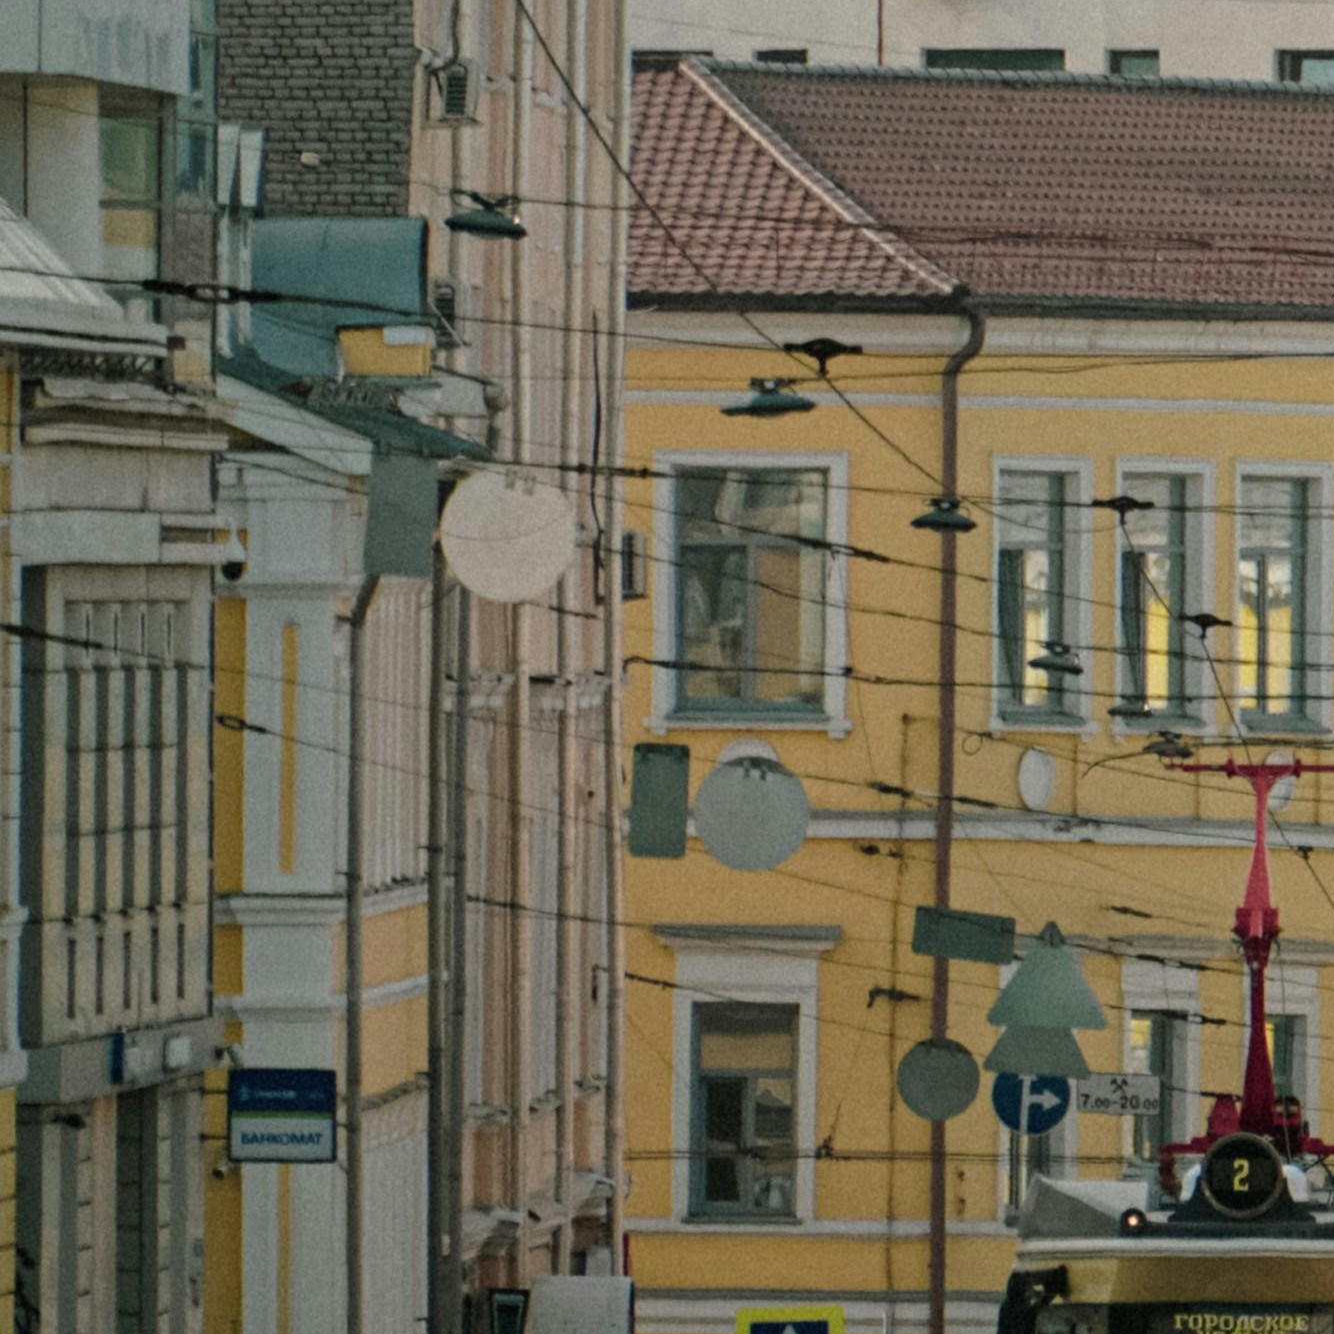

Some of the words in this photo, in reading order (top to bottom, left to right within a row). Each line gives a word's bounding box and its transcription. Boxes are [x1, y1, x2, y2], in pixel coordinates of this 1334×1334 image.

[241, 1132, 323, 1145] БАНКОМАТ
[1233, 1158, 1250, 1192] 2
[1174, 1314, 1309, 1332] ГОРОДСКОЕ
